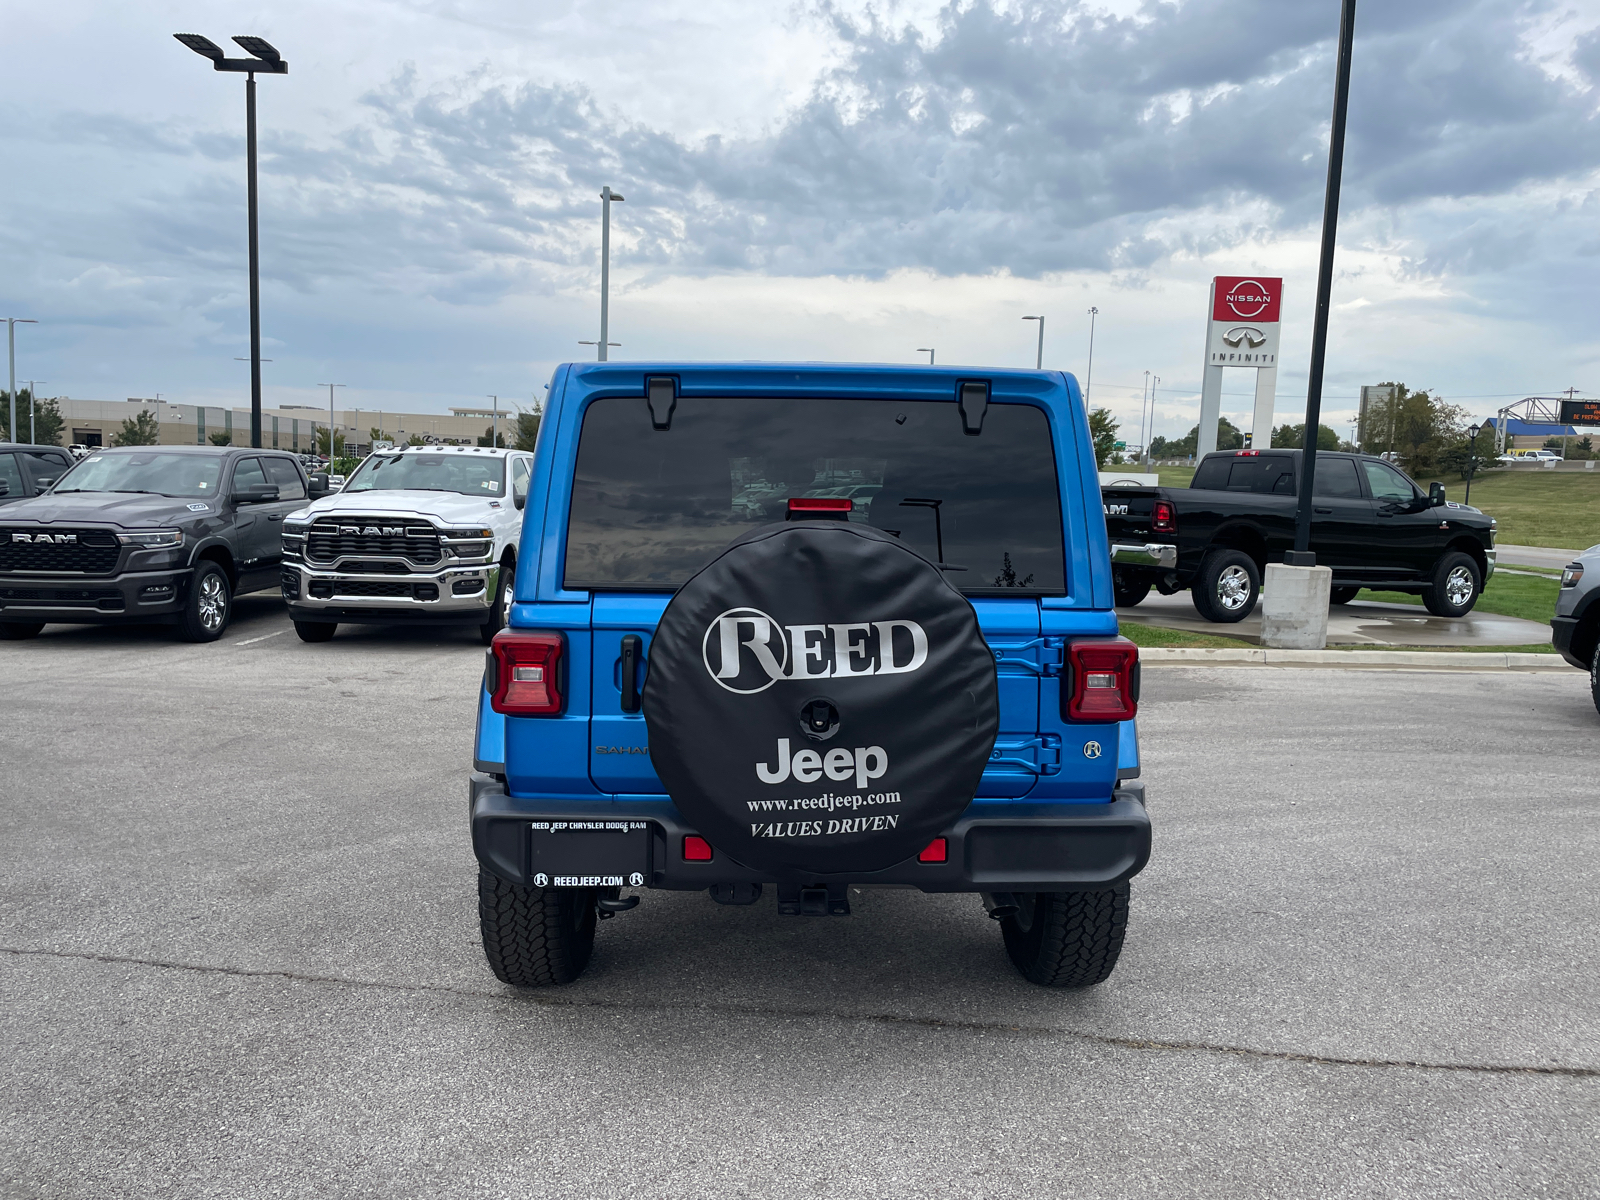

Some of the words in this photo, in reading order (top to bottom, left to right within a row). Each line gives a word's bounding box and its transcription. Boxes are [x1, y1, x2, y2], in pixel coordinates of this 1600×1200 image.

[1212, 353, 1274, 362] INFINITI
[340, 526, 404, 537] RAM
[12, 533, 77, 543] RAM
[712, 613, 929, 682] REED
[755, 738, 888, 789] Jeep
[747, 791, 901, 812] www.reedjeep.com
[551, 822, 568, 830] JEEP
[751, 820, 823, 838] VALUES
[826, 814, 899, 835] DRIVEN
[554, 876, 624, 886] REEDJEEP.COM
